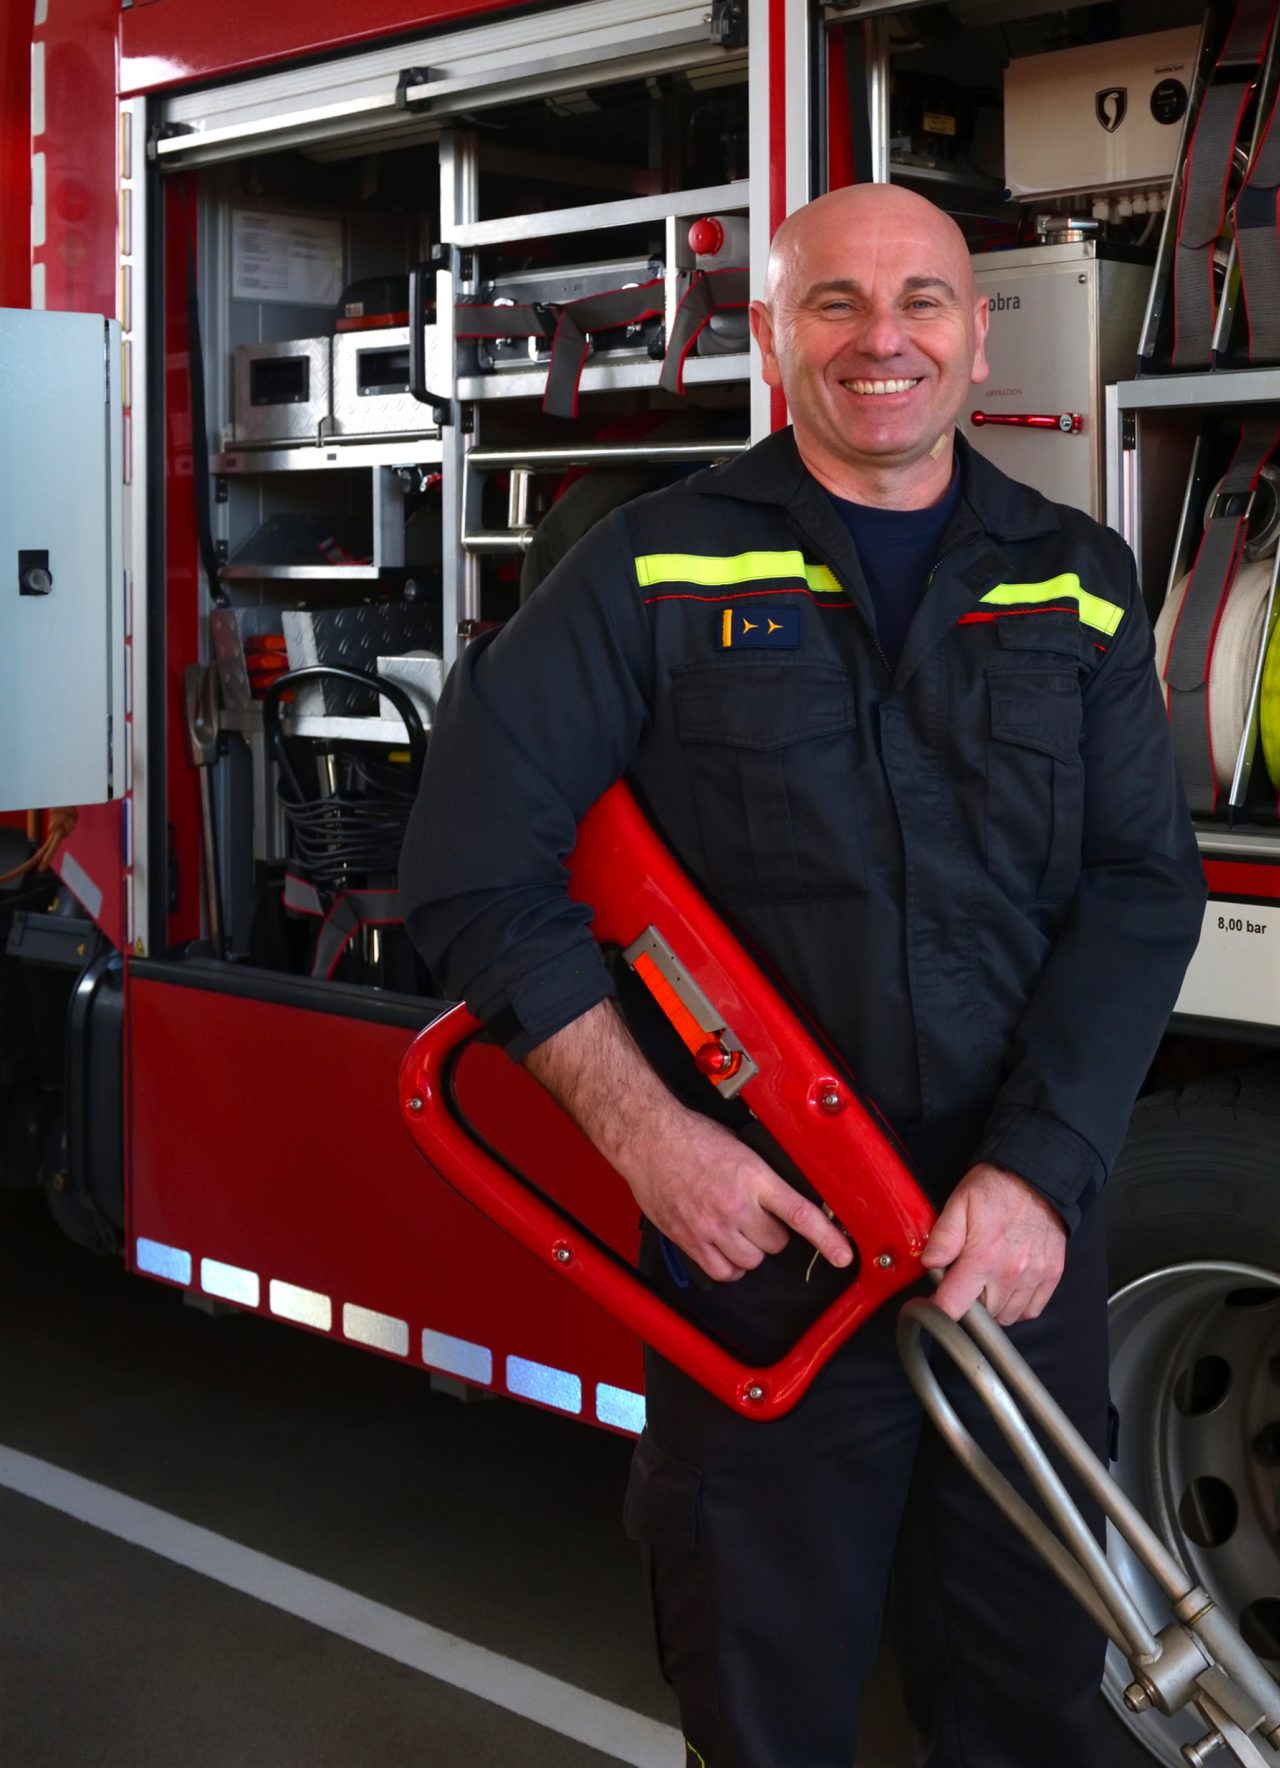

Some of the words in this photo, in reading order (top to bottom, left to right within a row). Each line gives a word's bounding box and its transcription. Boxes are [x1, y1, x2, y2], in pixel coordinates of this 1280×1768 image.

[988, 292, 1021, 312] obra
[1217, 916, 1243, 932] 8,00
[1246, 920, 1267, 934] bar
